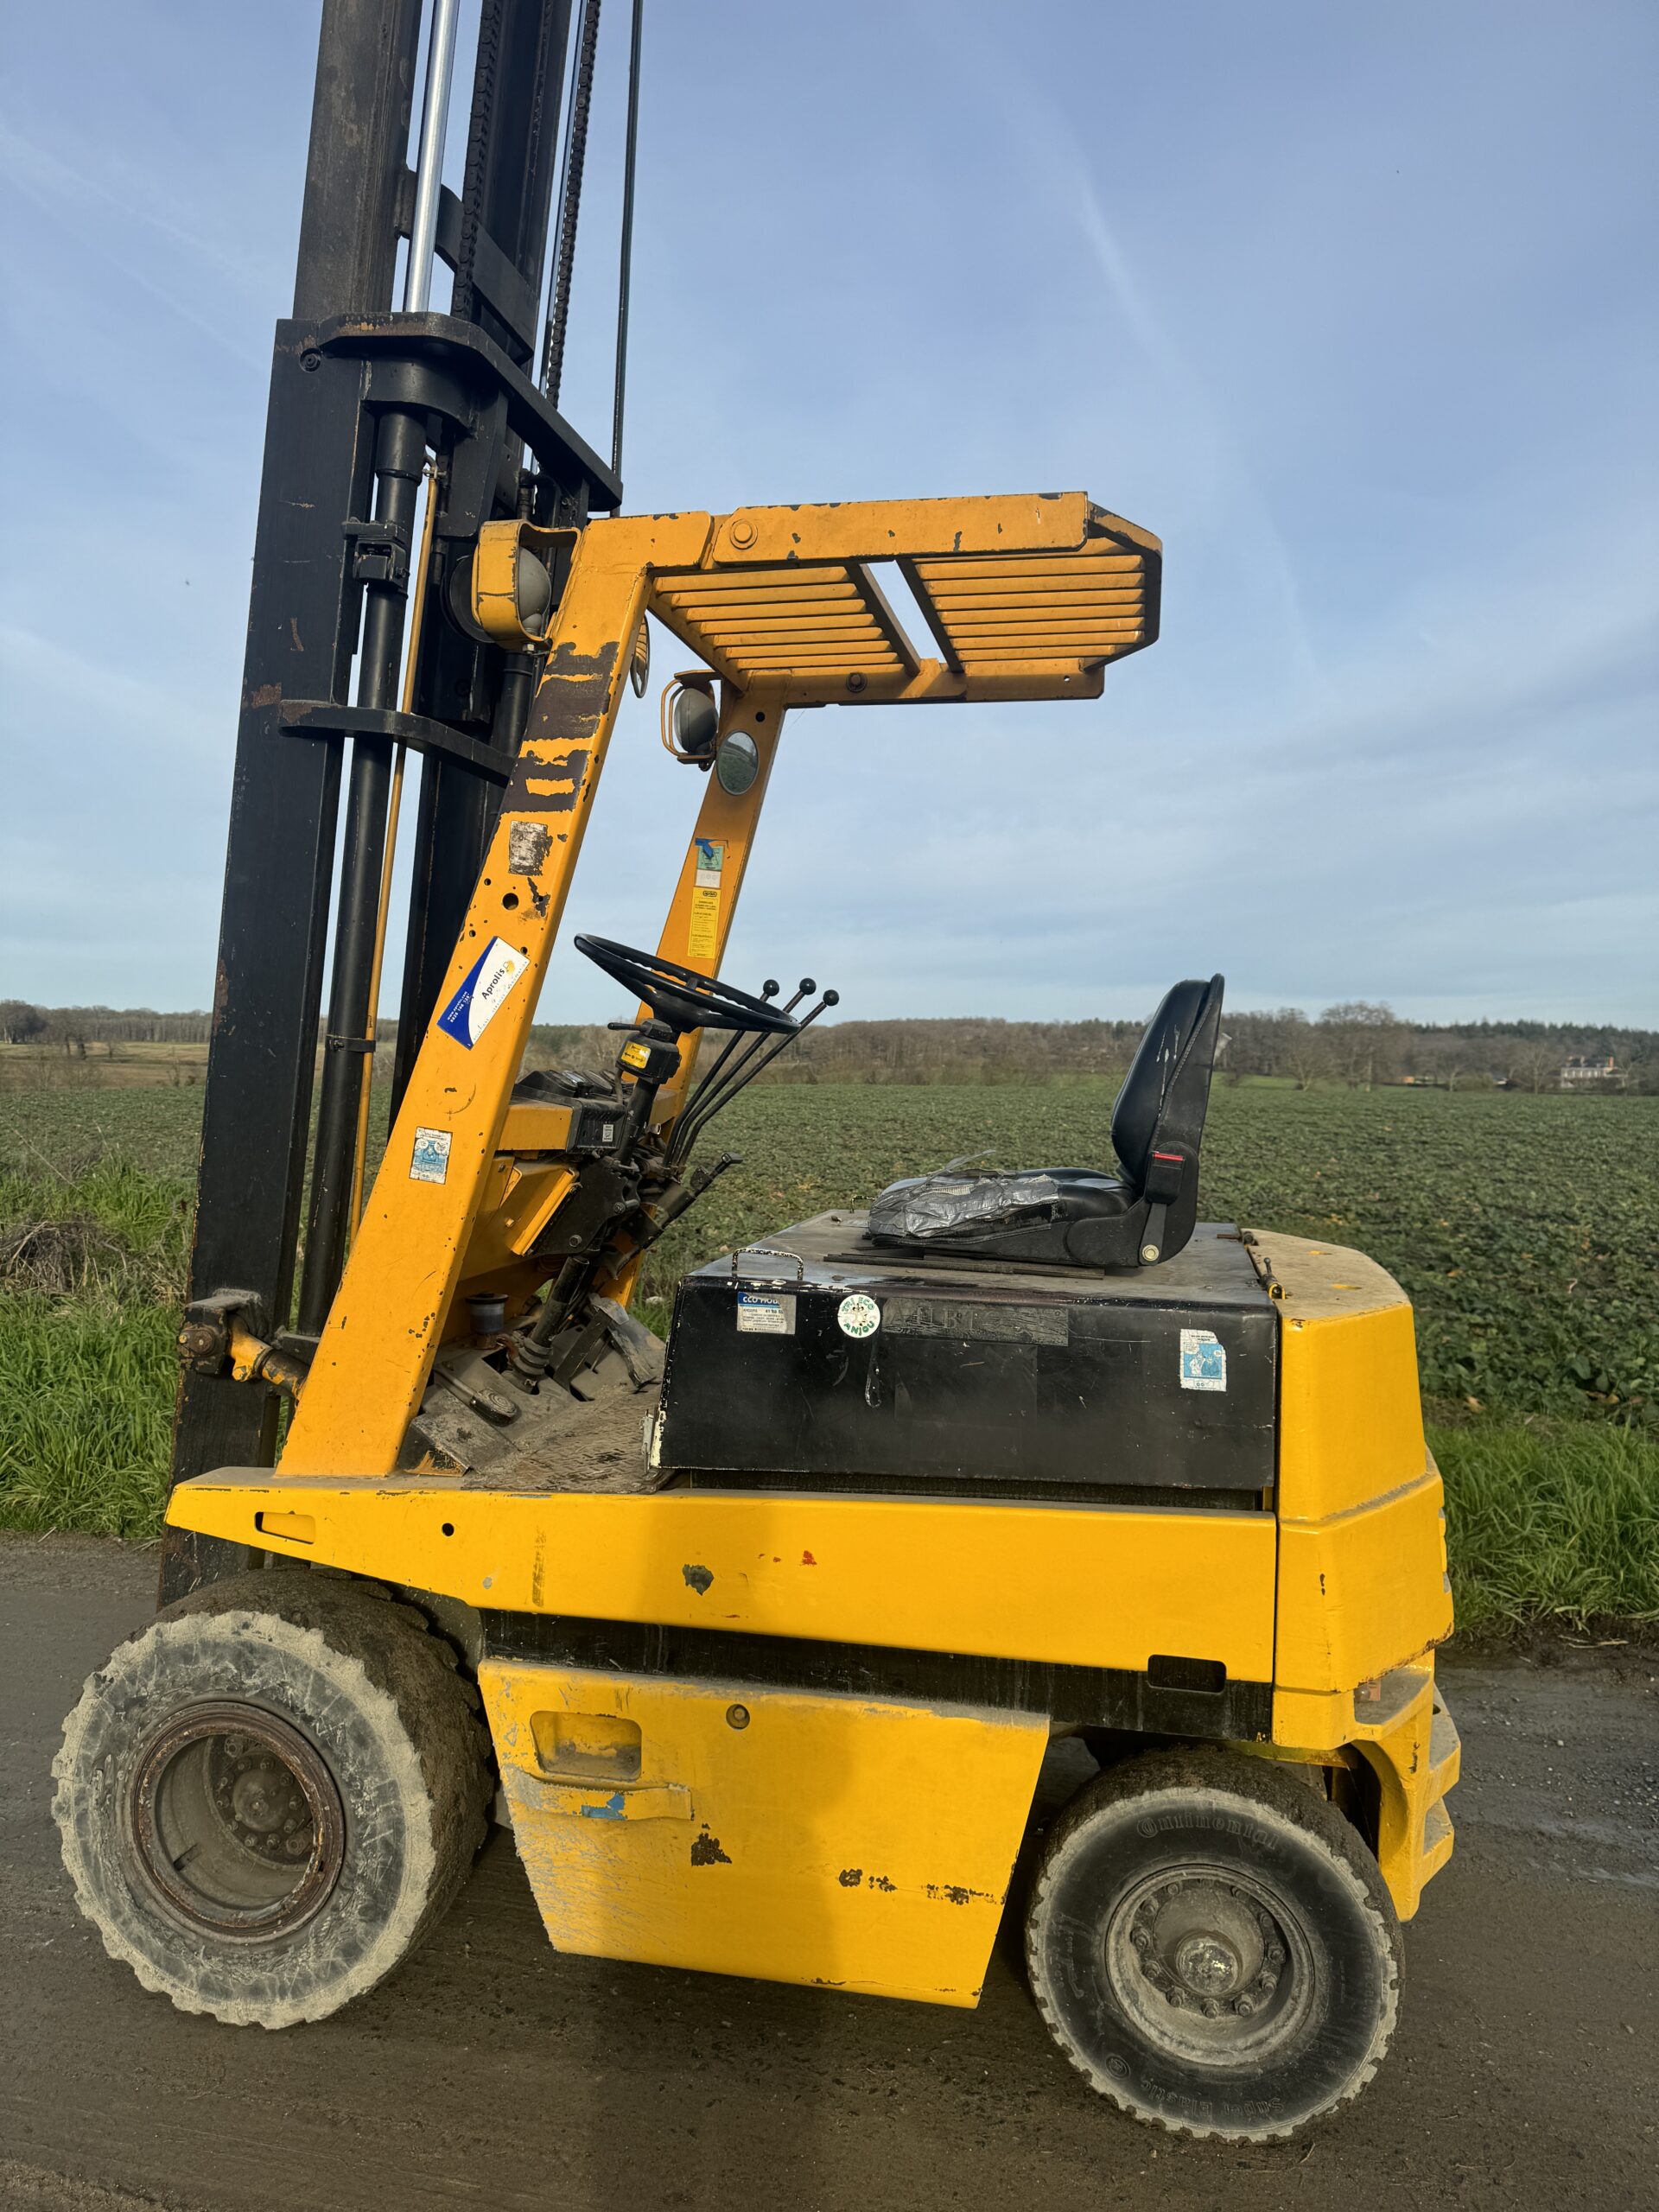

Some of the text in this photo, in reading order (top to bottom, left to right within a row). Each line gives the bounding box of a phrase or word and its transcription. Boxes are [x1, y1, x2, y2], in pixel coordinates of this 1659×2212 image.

[481, 968, 505, 1000] Aprolis
[841, 1296, 874, 1312] TRI ECO
[842, 1319, 874, 1336] ANJOU
[1136, 1812, 1281, 1851] Continental
[1222, 2096, 1285, 2116] Super
